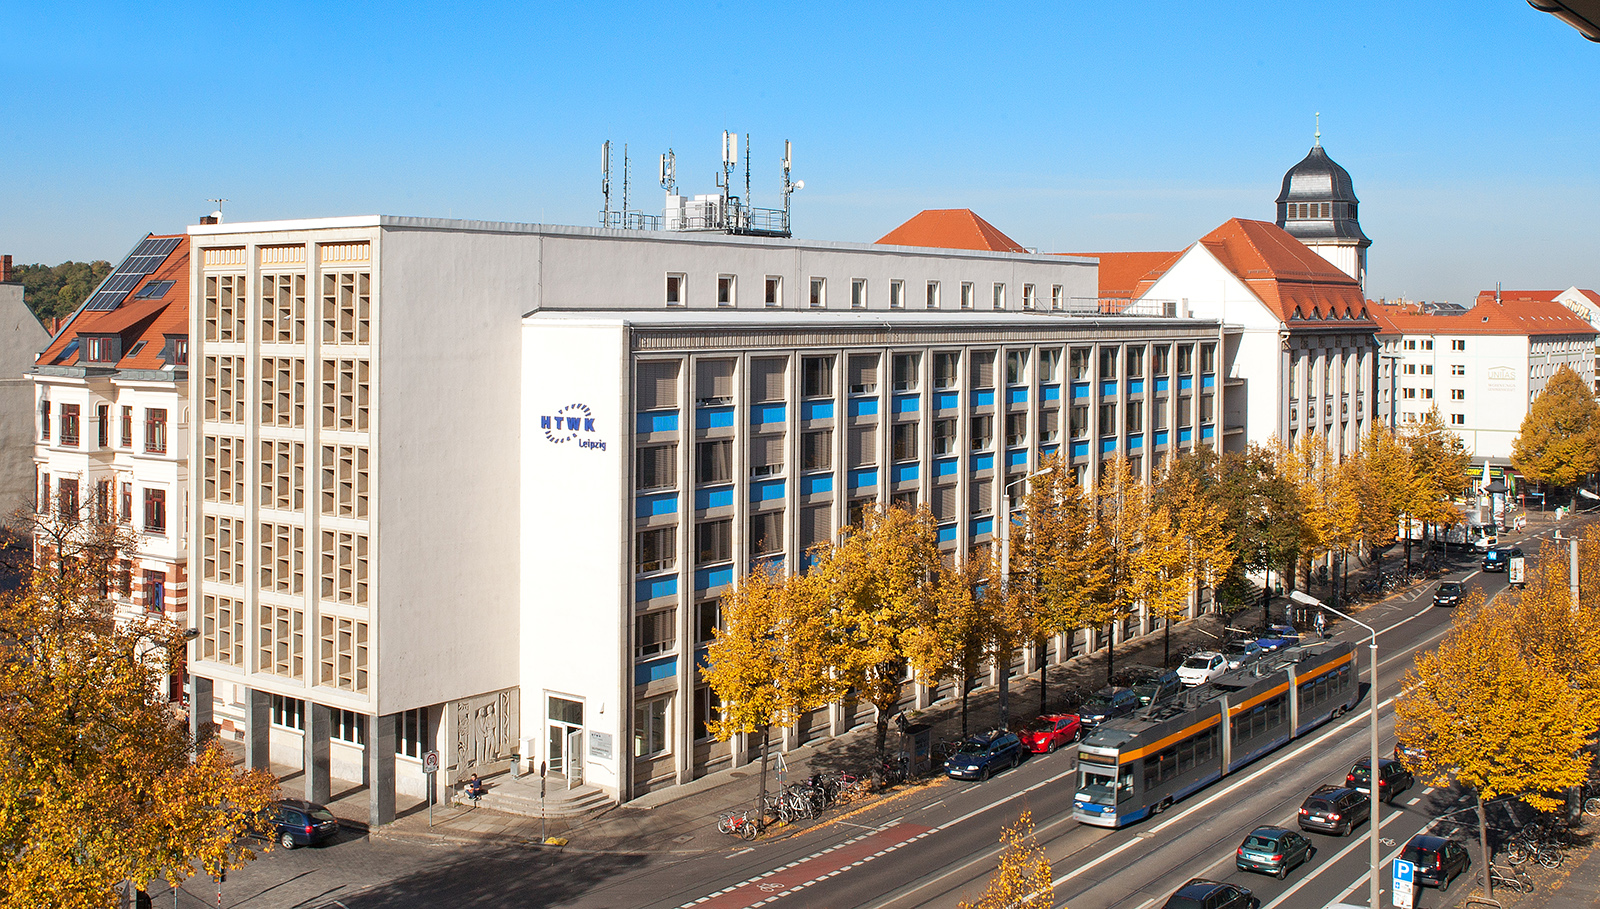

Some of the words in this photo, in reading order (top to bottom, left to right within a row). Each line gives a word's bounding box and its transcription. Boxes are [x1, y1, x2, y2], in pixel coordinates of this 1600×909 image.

[1487, 368, 1516, 379] UNITAS
[540, 415, 596, 433] HTWK
[578, 438, 607, 451] Leipzig
[1398, 862, 1410, 878] P
